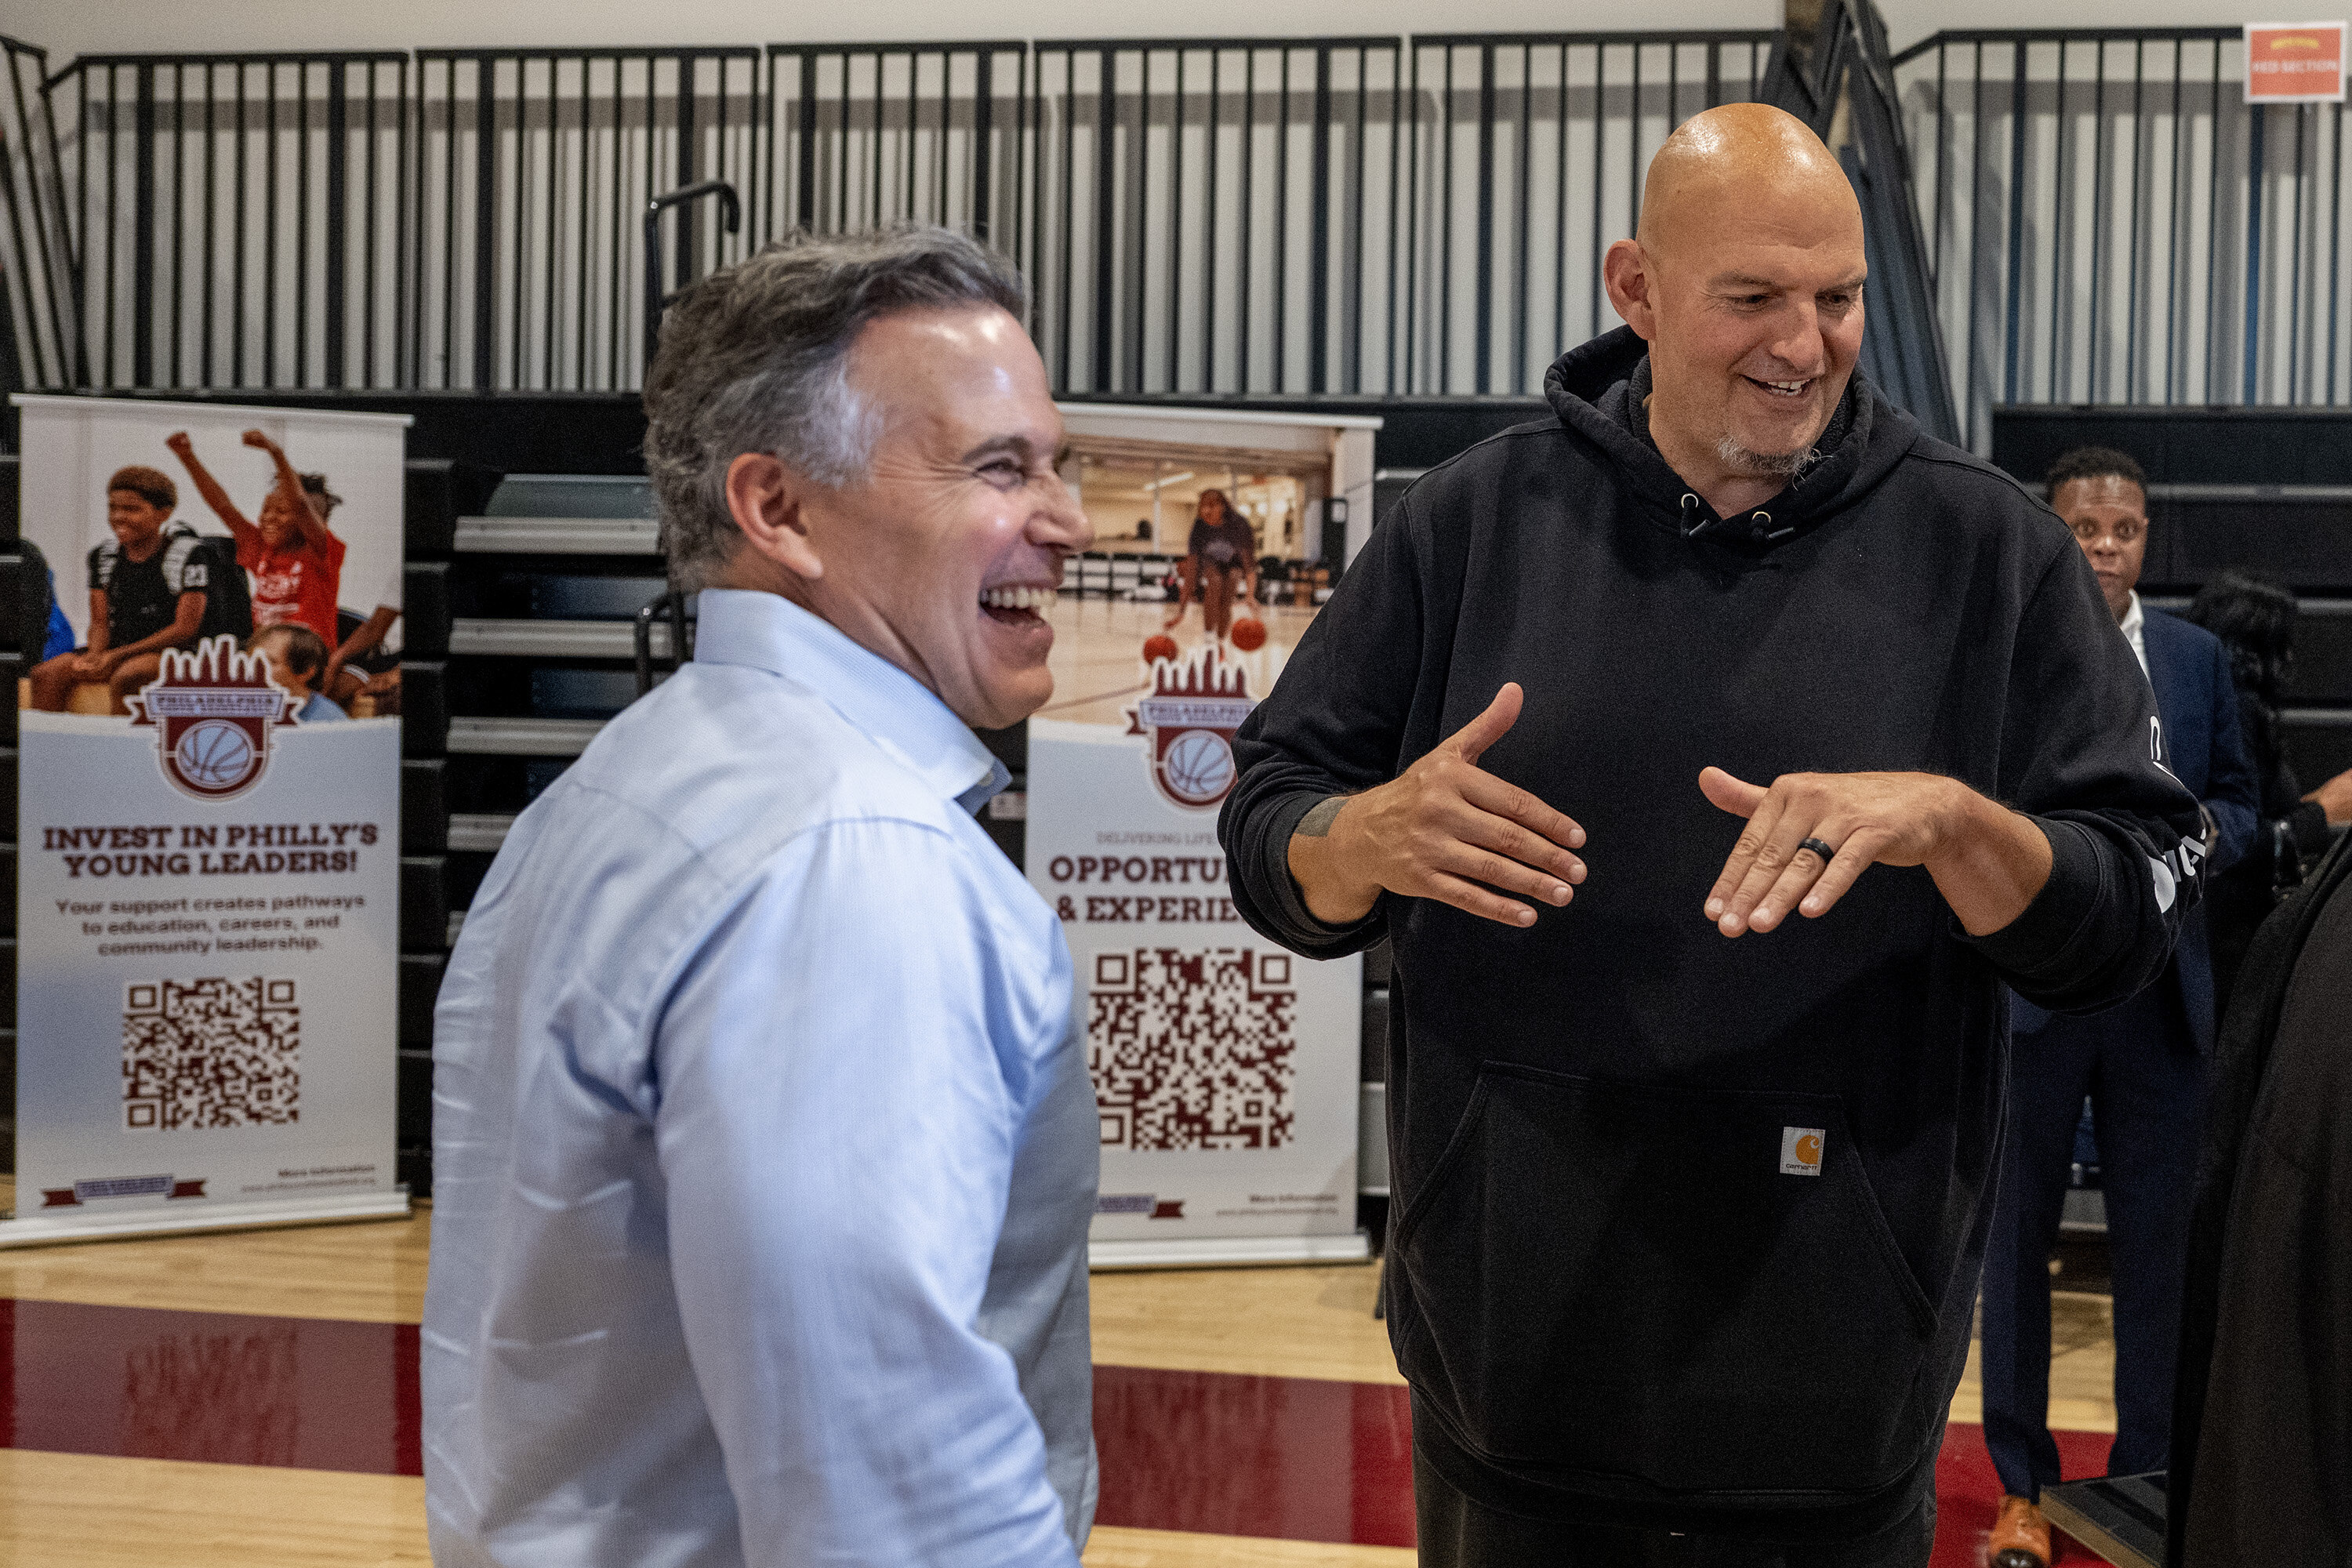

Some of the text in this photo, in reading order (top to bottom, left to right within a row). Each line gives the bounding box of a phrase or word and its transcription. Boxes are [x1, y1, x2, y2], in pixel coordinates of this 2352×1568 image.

[42, 822, 379, 851] INVEST IN PHILLY'S
[63, 849, 358, 878] YOUNG LEADERS!
[1048, 855, 1229, 884] OPPORTU
[56, 895, 366, 916] Your support creates pathways
[1056, 895, 1243, 923] & EXPERIE
[82, 914, 341, 936] to education, careers, and
[97, 935, 323, 956] community leadership.
